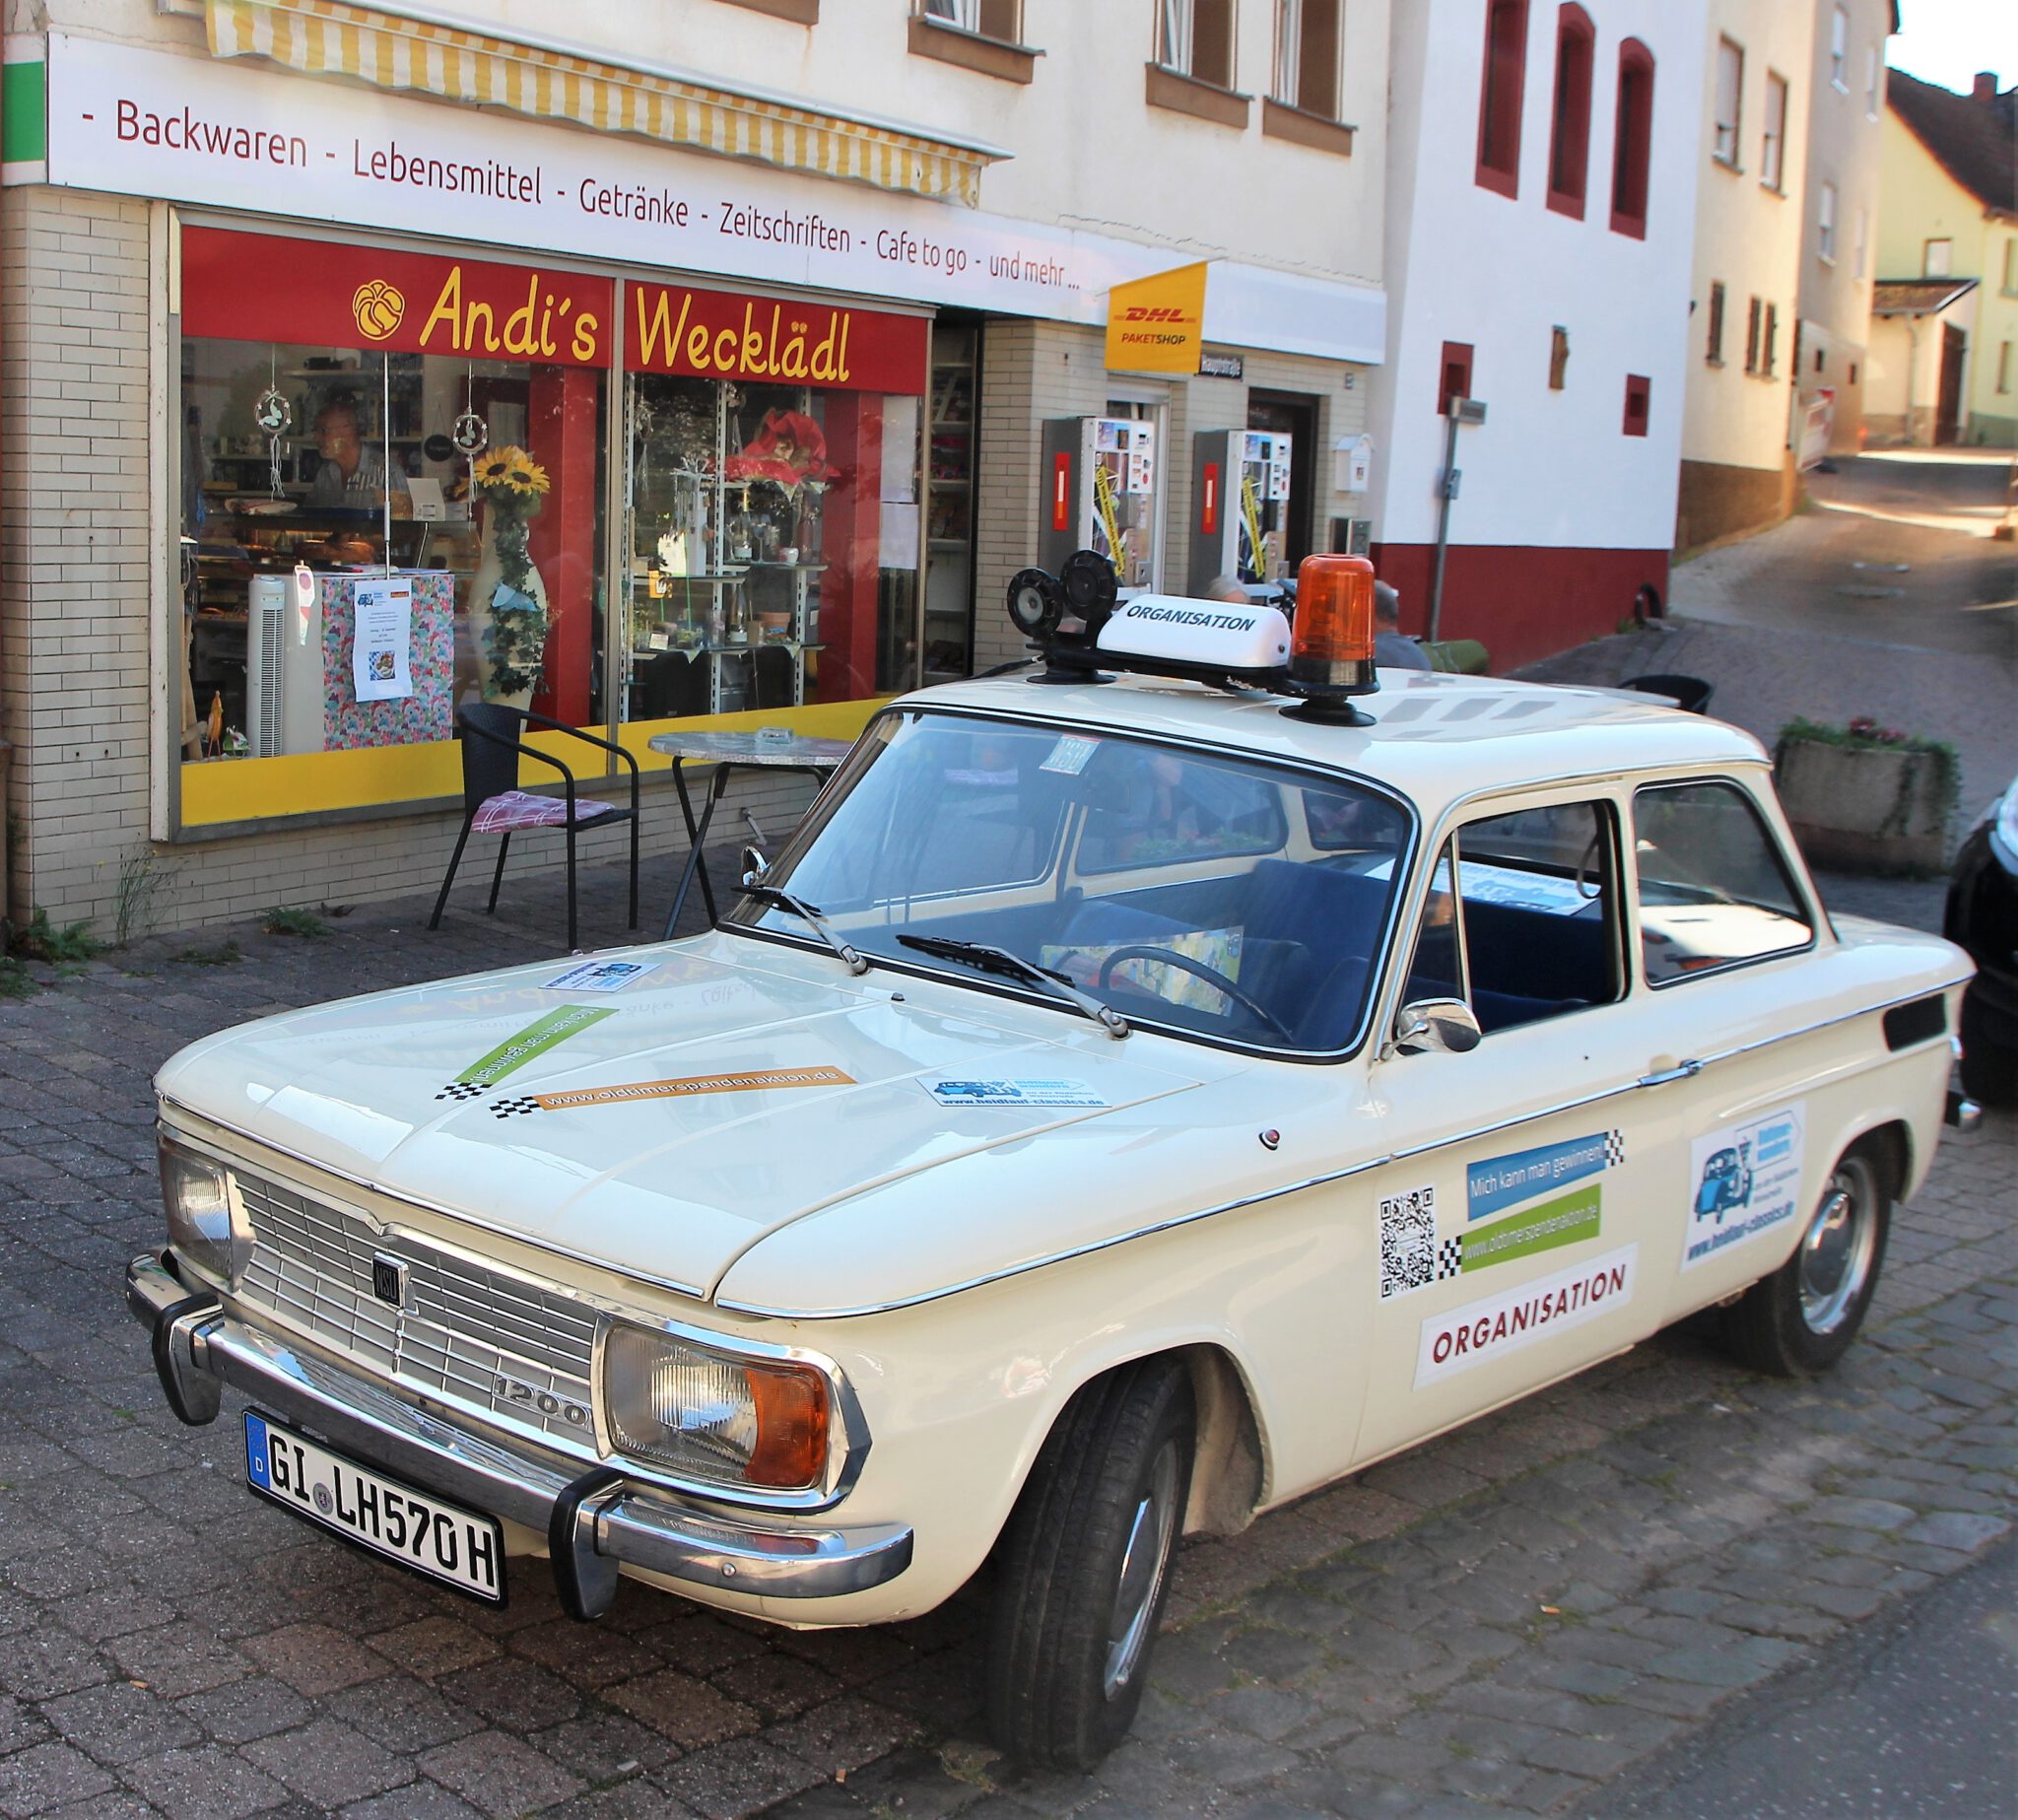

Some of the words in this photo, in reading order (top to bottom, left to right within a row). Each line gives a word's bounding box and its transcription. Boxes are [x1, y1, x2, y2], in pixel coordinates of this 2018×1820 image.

[117, 99, 307, 168] Backwaren
[354, 139, 542, 205] Lebensmittel
[579, 177, 689, 228] Getränke
[719, 202, 850, 253] Zeitschriften
[876, 229, 917, 264] Cafe
[922, 237, 941, 268] to
[945, 247, 968, 277] go
[989, 250, 1021, 280] und
[419, 266, 598, 362] Andi's
[637, 287, 849, 382] Wecklädl
[1125, 307, 1185, 323] DHL
[1120, 332, 1186, 345] PAKETSHOP
[1126, 604, 1256, 633] ORGANISATION
[545, 1070, 840, 1106] www.oldtimerspendenaktion.de
[1470, 1174, 1499, 1198] Mich
[1500, 1169, 1526, 1189] kann
[1528, 1161, 1552, 1180] man
[375, 1265, 397, 1300] NSU
[1433, 1264, 1626, 1364] ORGANISATION
[497, 1376, 588, 1425] 1200
[254, 1455, 264, 1473] D
[268, 1433, 311, 1504] GI
